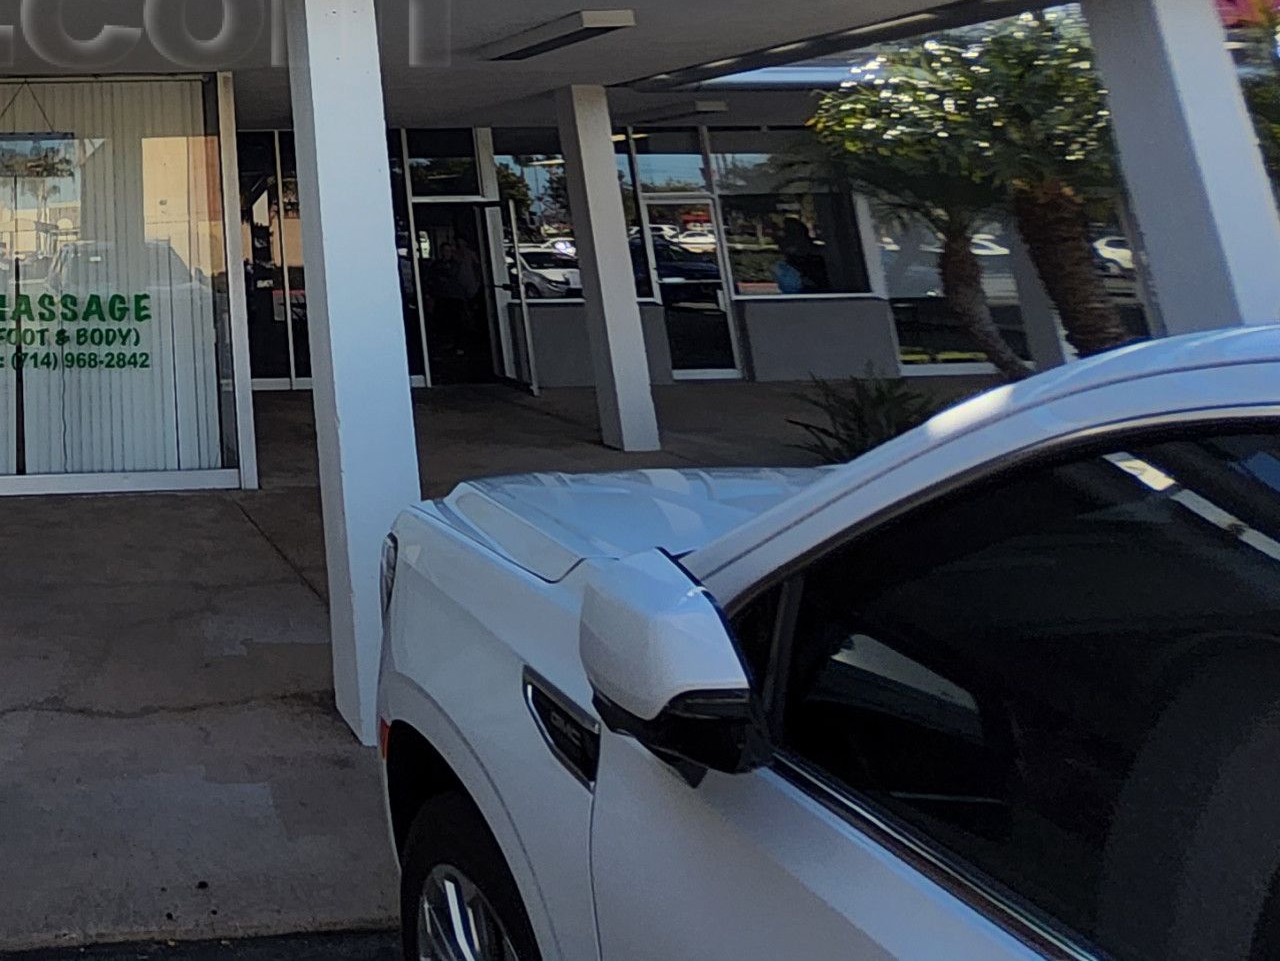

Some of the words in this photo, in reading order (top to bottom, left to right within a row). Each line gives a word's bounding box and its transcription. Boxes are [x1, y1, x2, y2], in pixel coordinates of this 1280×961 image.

[55, 328, 70, 346] &
[76, 327, 141, 346] BODY)
[11, 352, 59, 371] (714)
[64, 352, 151, 369] 968-2842
